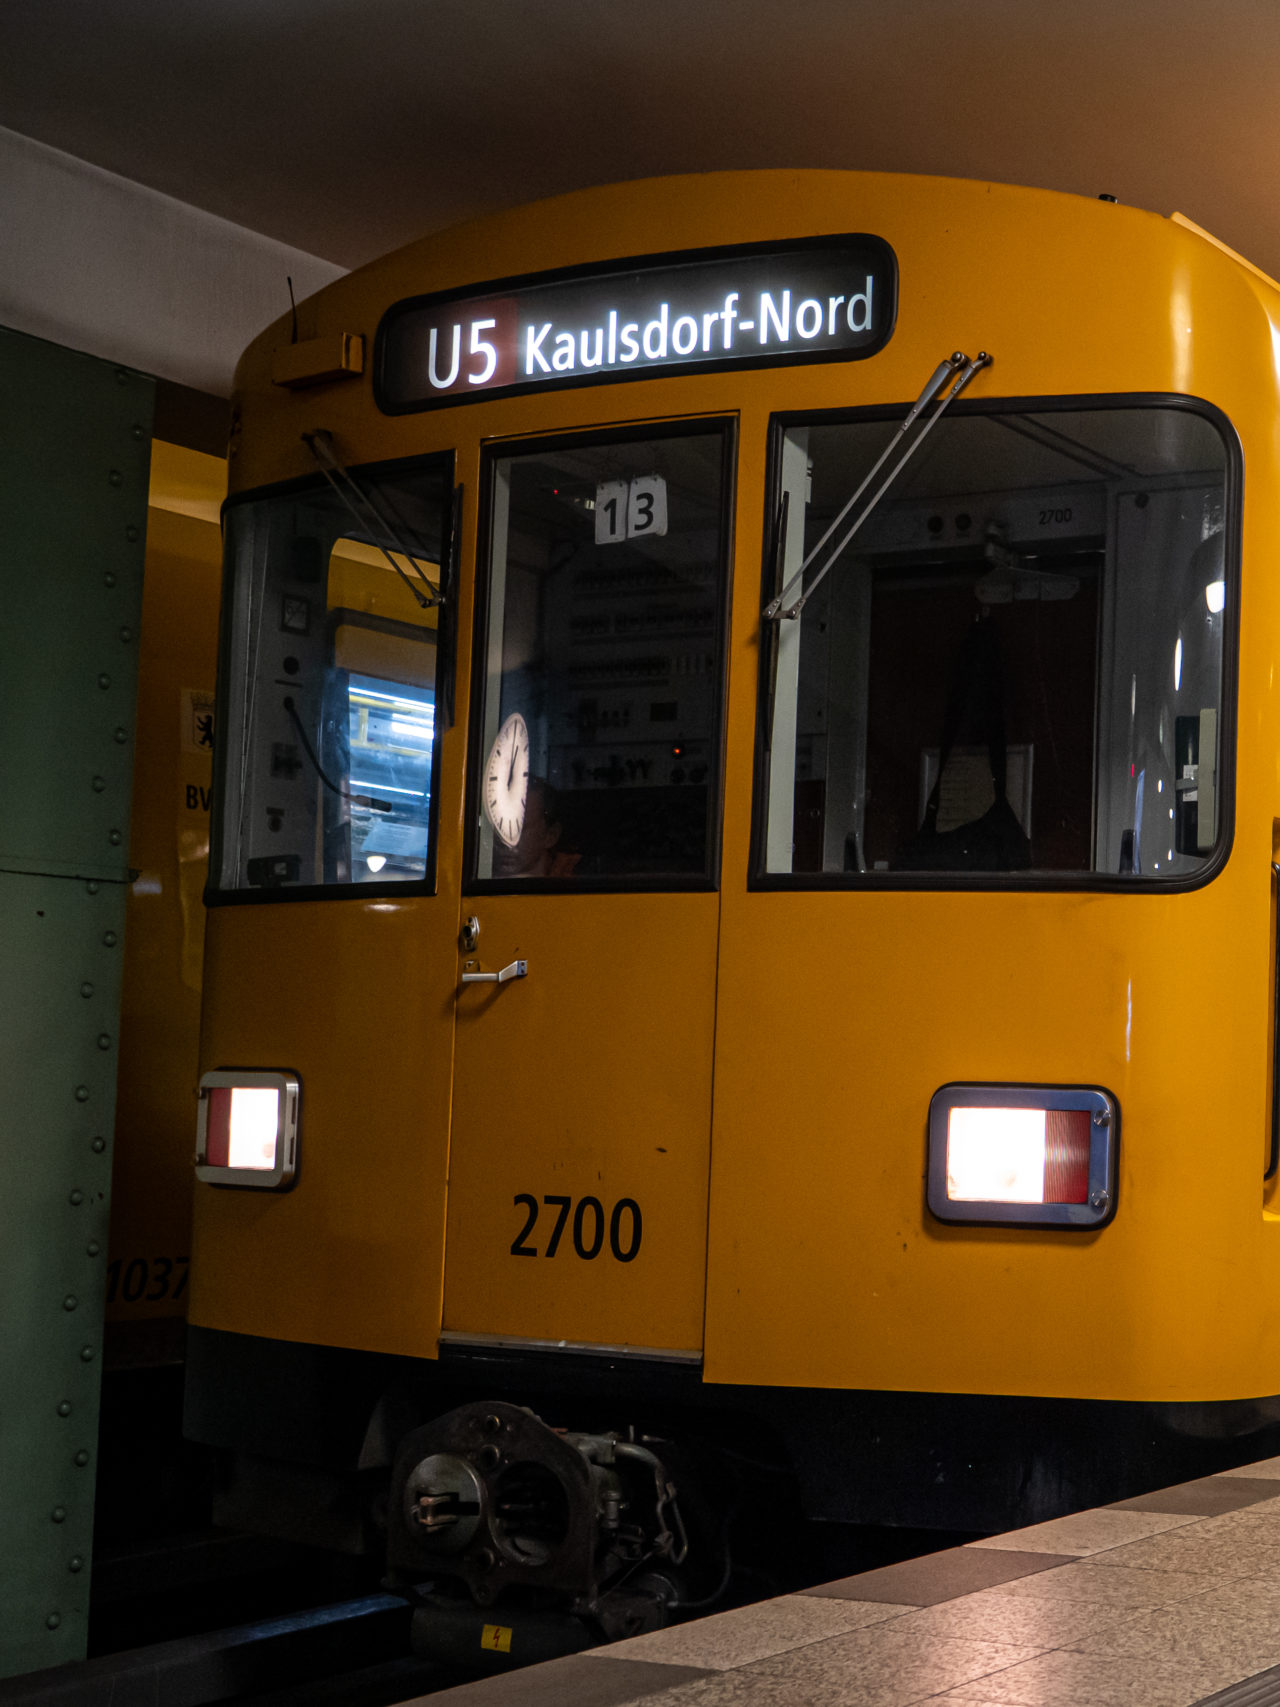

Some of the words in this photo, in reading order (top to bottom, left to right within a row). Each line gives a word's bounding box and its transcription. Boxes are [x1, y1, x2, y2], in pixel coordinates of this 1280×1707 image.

[428, 319, 497, 389] U5
[525, 275, 874, 375] Kaulsdorf-Nord
[604, 493, 654, 535] 13
[1039, 508, 1072, 525] 2700
[510, 1194, 642, 1263] 2700
[107, 1257, 189, 1302] 1037
